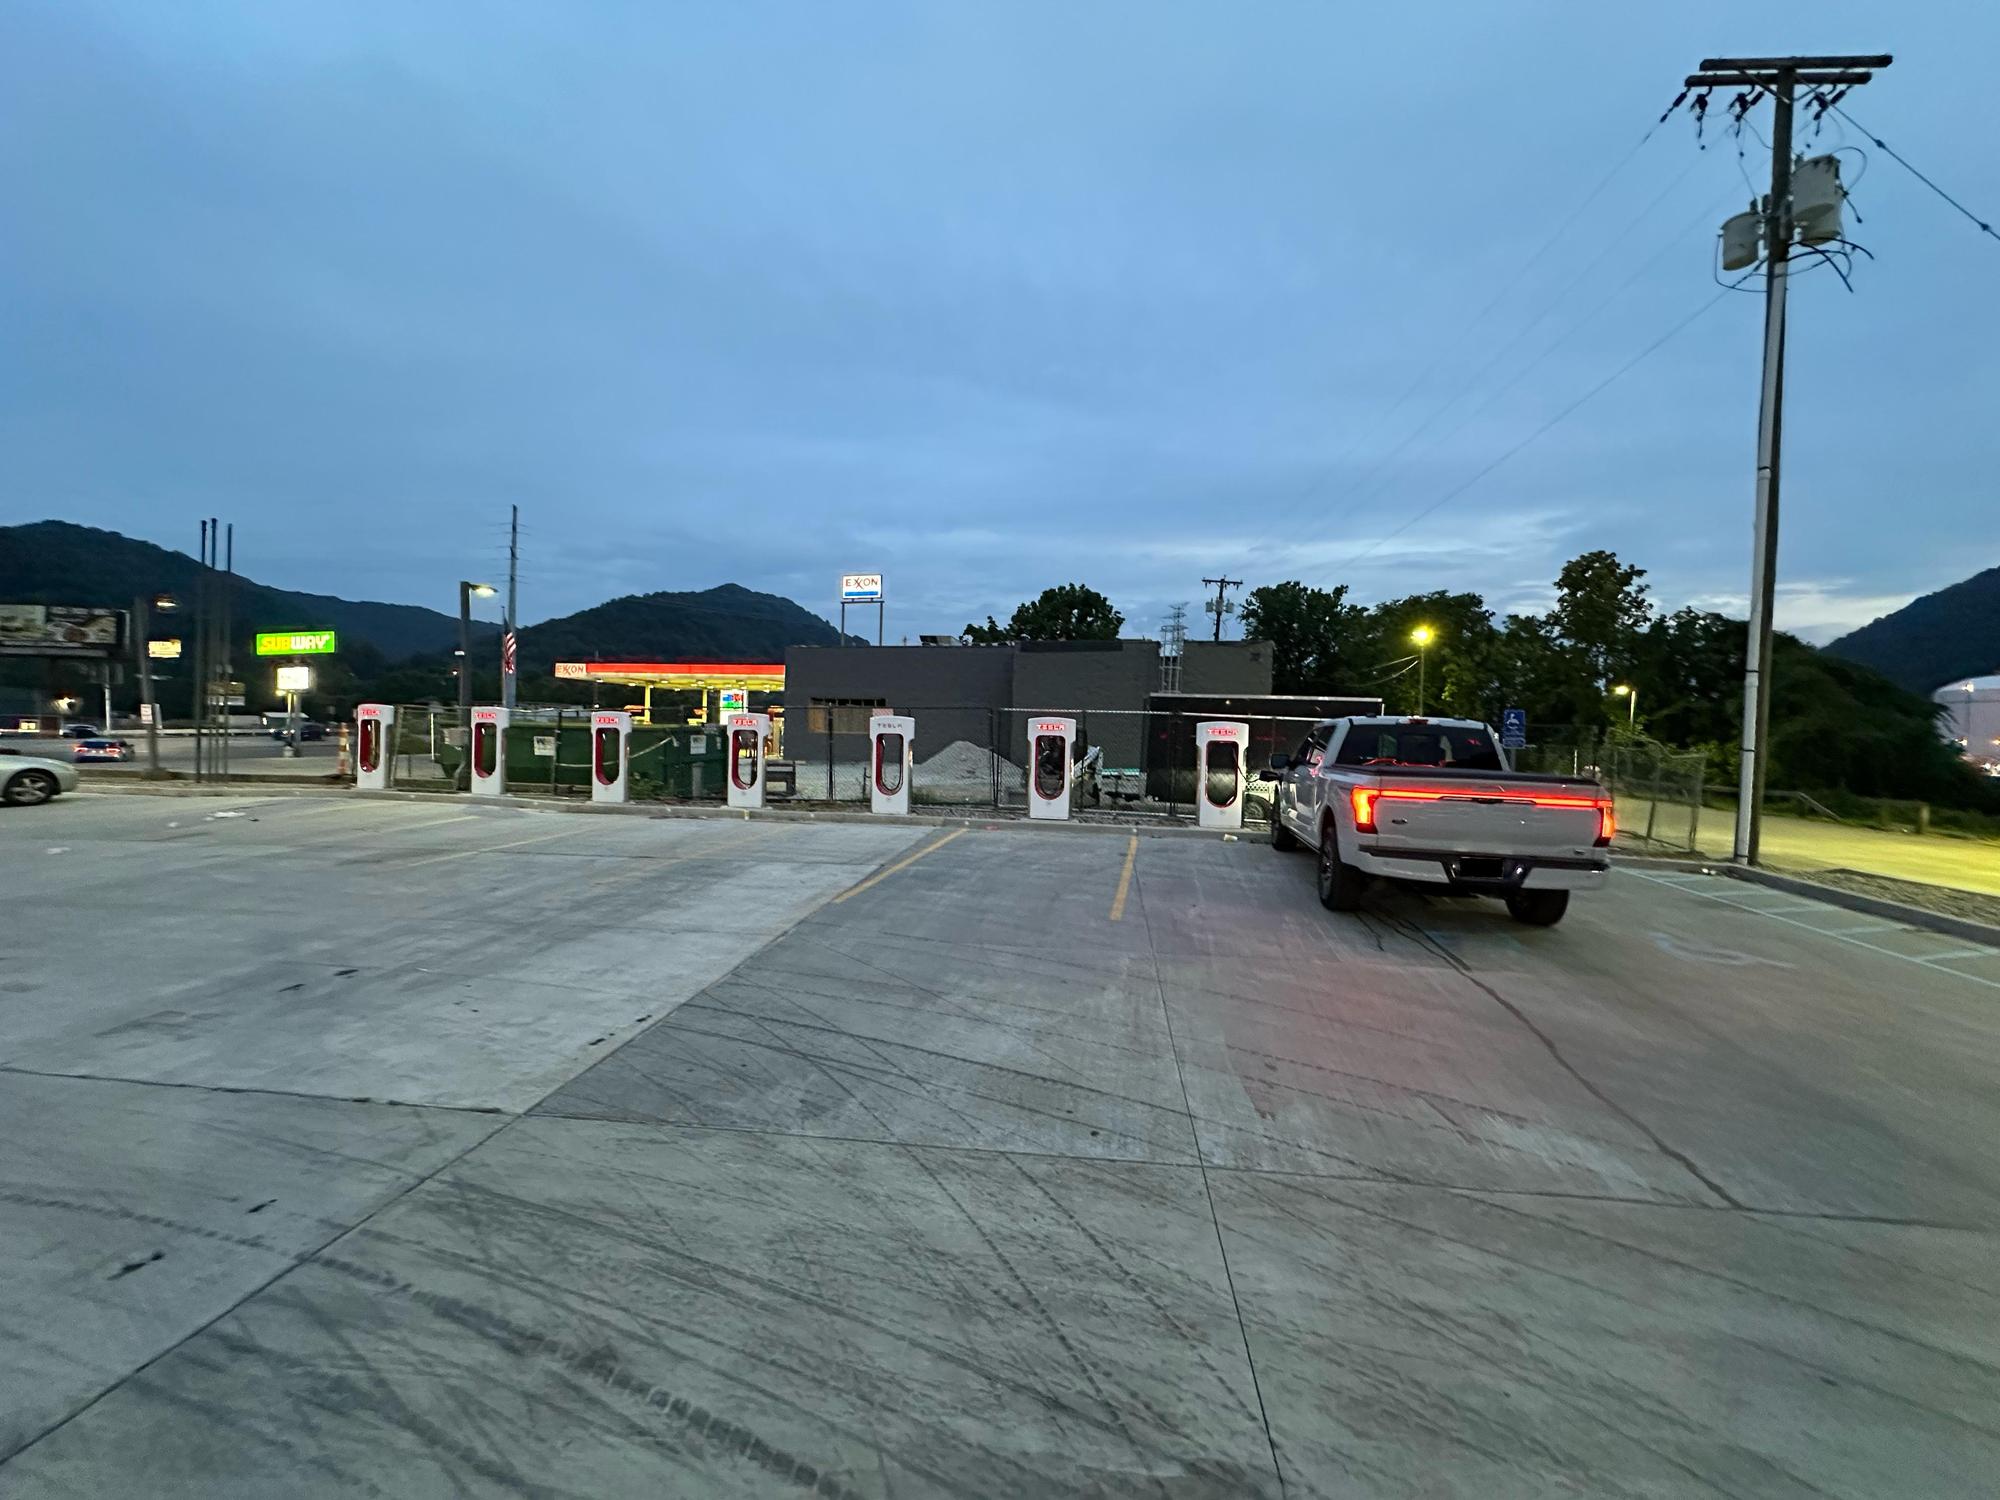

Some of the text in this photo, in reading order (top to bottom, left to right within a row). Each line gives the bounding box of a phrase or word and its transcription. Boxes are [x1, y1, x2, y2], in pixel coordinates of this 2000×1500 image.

[845, 577, 878, 590] EXXON
[259, 635, 329, 653] SUBWAY
[556, 664, 584, 676] EXXON
[1036, 723, 1065, 731] TESLA
[1207, 728, 1239, 736] TESLA
